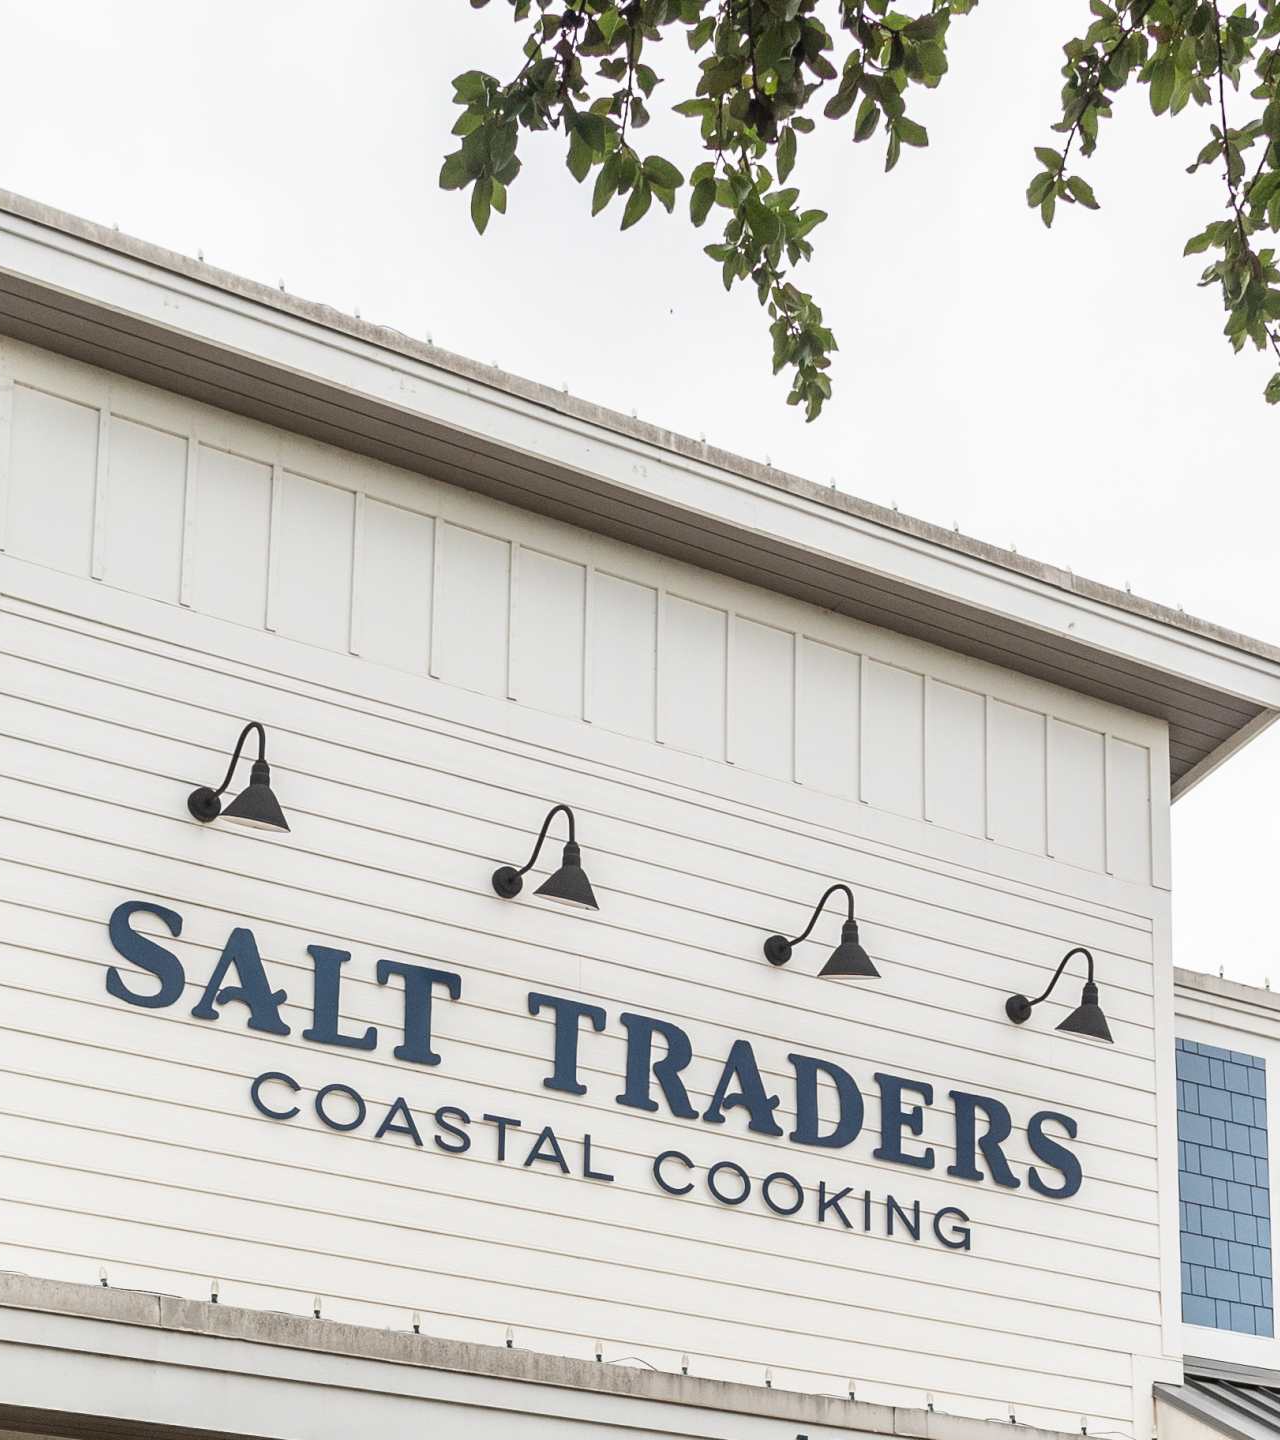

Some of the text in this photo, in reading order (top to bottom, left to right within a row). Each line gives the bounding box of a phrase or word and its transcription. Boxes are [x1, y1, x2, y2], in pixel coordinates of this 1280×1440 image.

[106, 900, 1082, 1199] SALT TRADERS
[250, 1071, 971, 1251] COASTAL COOKING
